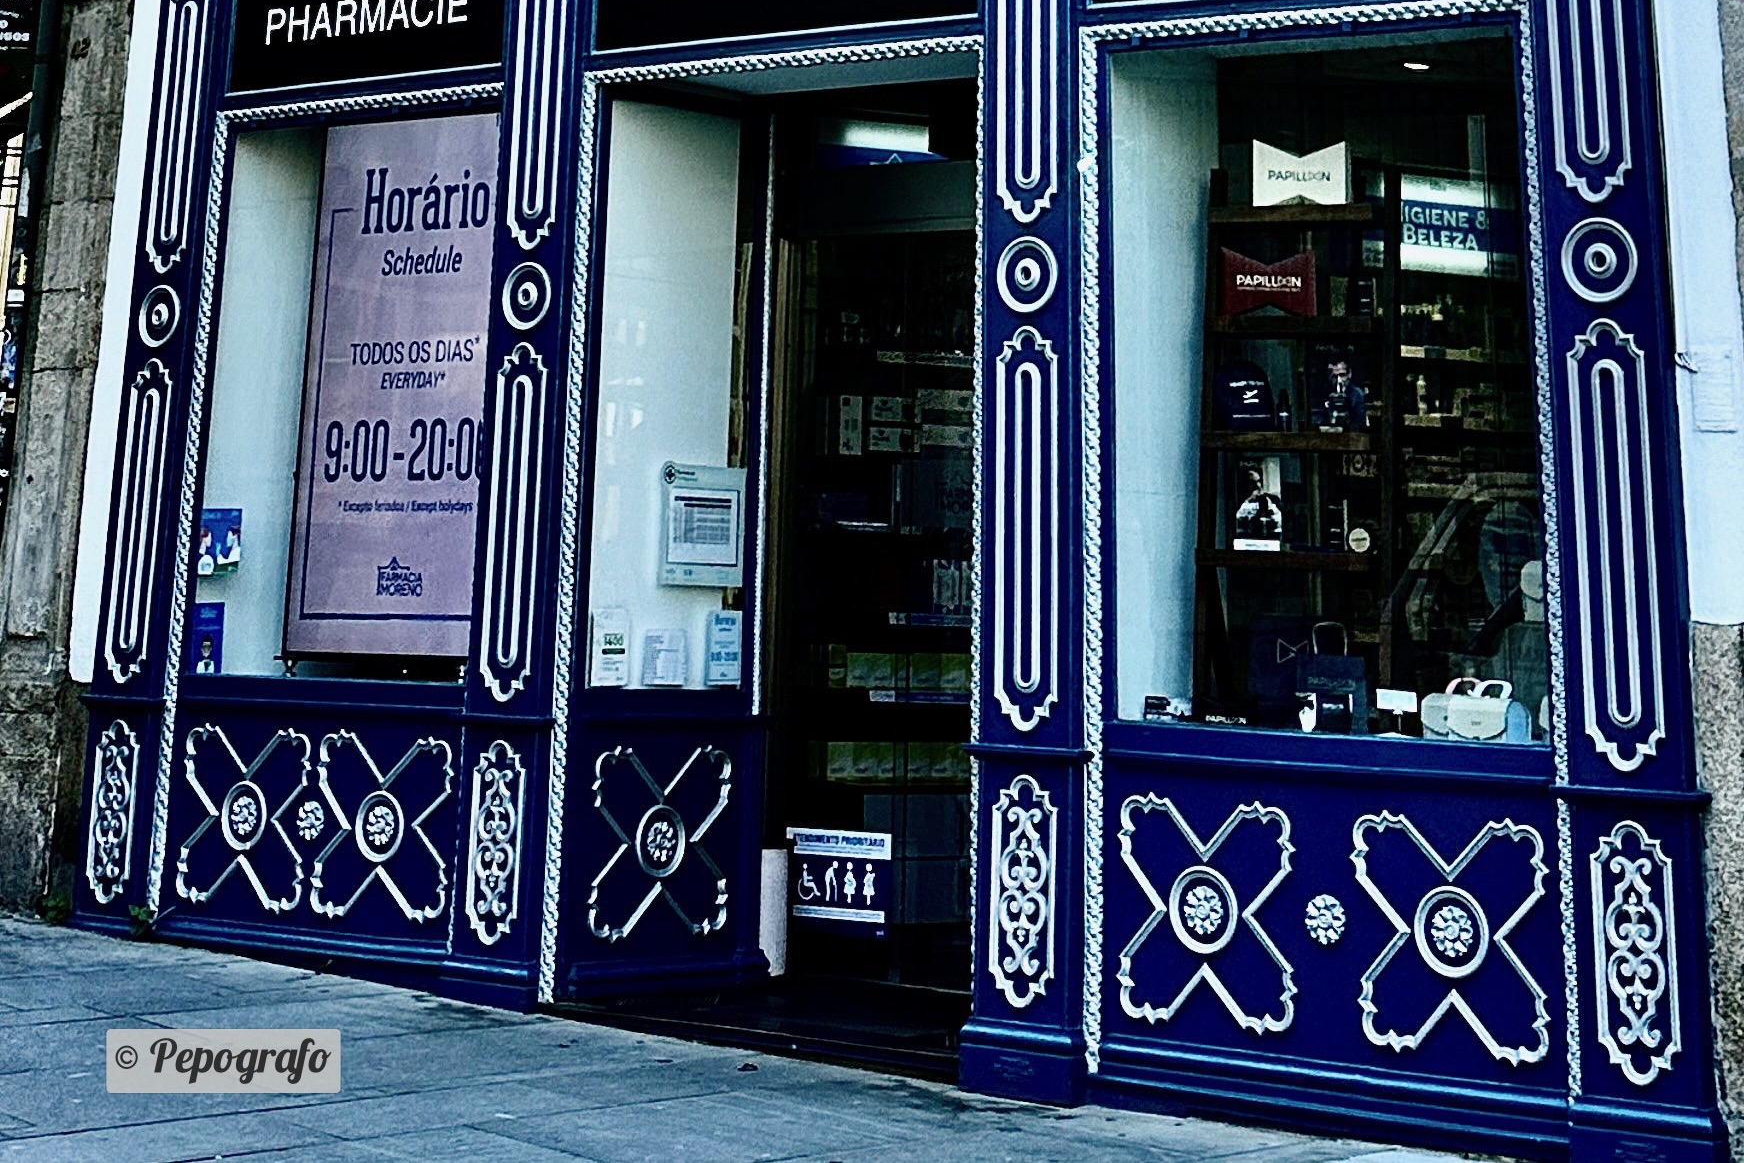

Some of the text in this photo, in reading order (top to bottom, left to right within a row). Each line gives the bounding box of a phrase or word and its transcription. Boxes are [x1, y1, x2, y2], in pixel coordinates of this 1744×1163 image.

[361, 167, 490, 234] Horário
[1403, 223, 1478, 251] BELEZA
[381, 245, 463, 276] Schedule
[351, 341, 404, 365] TODOS
[409, 340, 431, 364] OS
